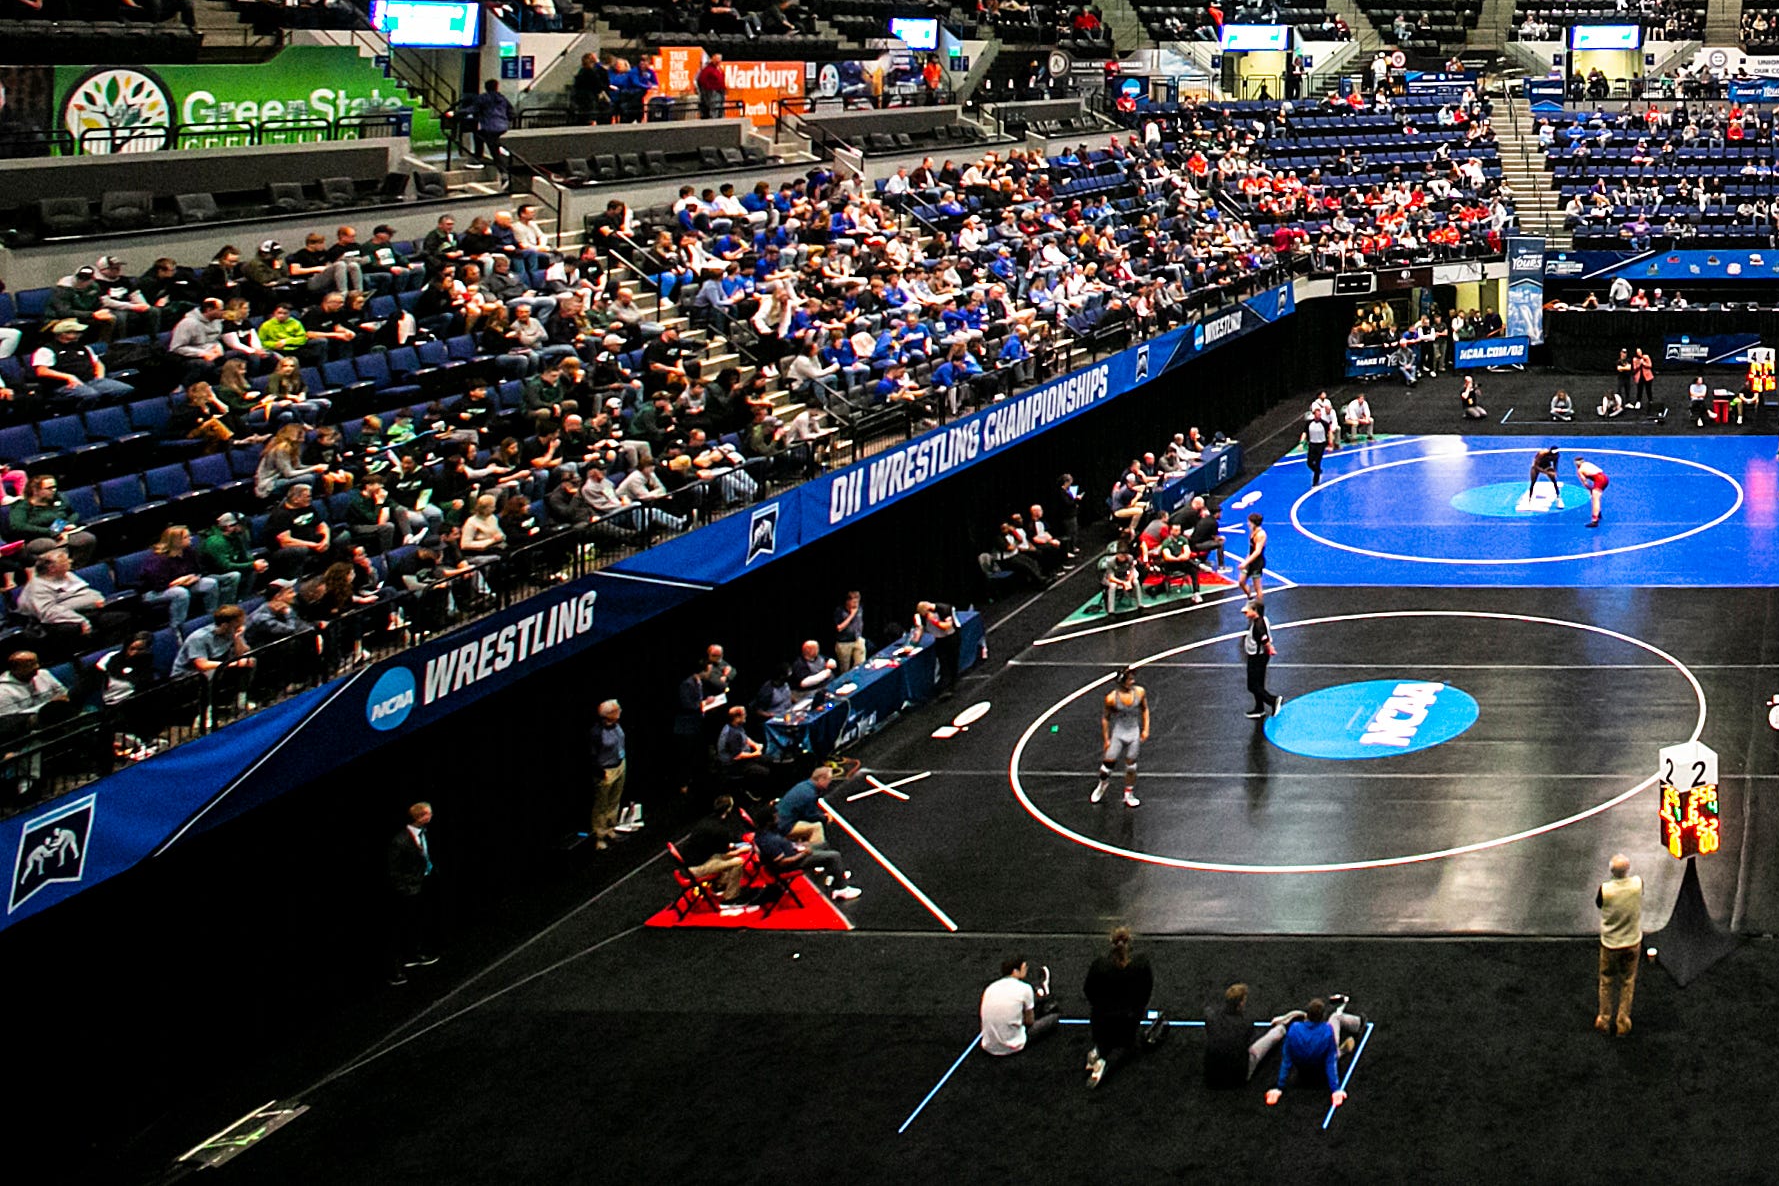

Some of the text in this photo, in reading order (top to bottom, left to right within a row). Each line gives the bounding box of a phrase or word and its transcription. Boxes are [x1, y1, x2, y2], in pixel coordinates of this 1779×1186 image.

[721, 62, 798, 94] Wartburg
[1204, 311, 1243, 345] WRESTLING
[1751, 351, 1757, 361] 4
[1764, 350, 1770, 360] 4
[830, 364, 1109, 525] DII WRESTLING CHAMPIONSHIPS
[370, 590, 598, 722] NCAA WRESTLING
[1359, 681, 1445, 747] NCAA
[1665, 757, 1674, 786] 2
[1691, 760, 1706, 788] 2
[1706, 800, 1719, 815] 4
